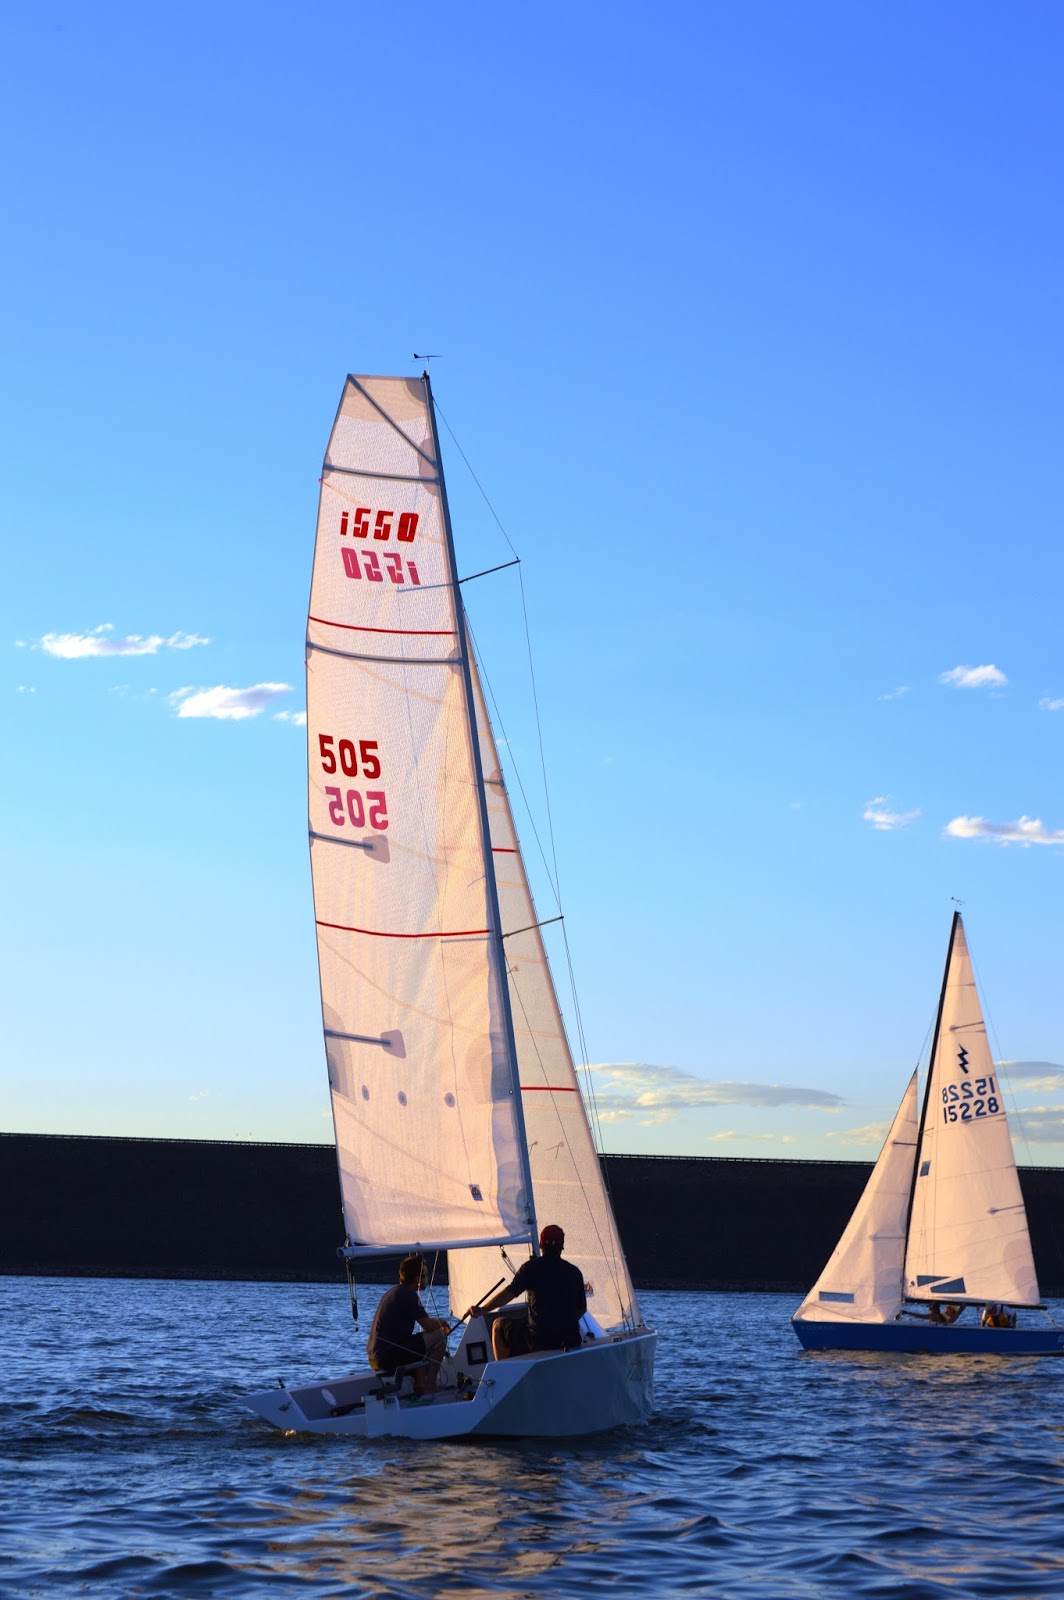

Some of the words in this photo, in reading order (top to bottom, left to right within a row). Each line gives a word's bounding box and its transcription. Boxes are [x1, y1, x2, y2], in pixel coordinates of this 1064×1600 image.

[340, 508, 419, 542] i550
[319, 734, 381, 779] 505
[943, 1096, 999, 1124] 15228
